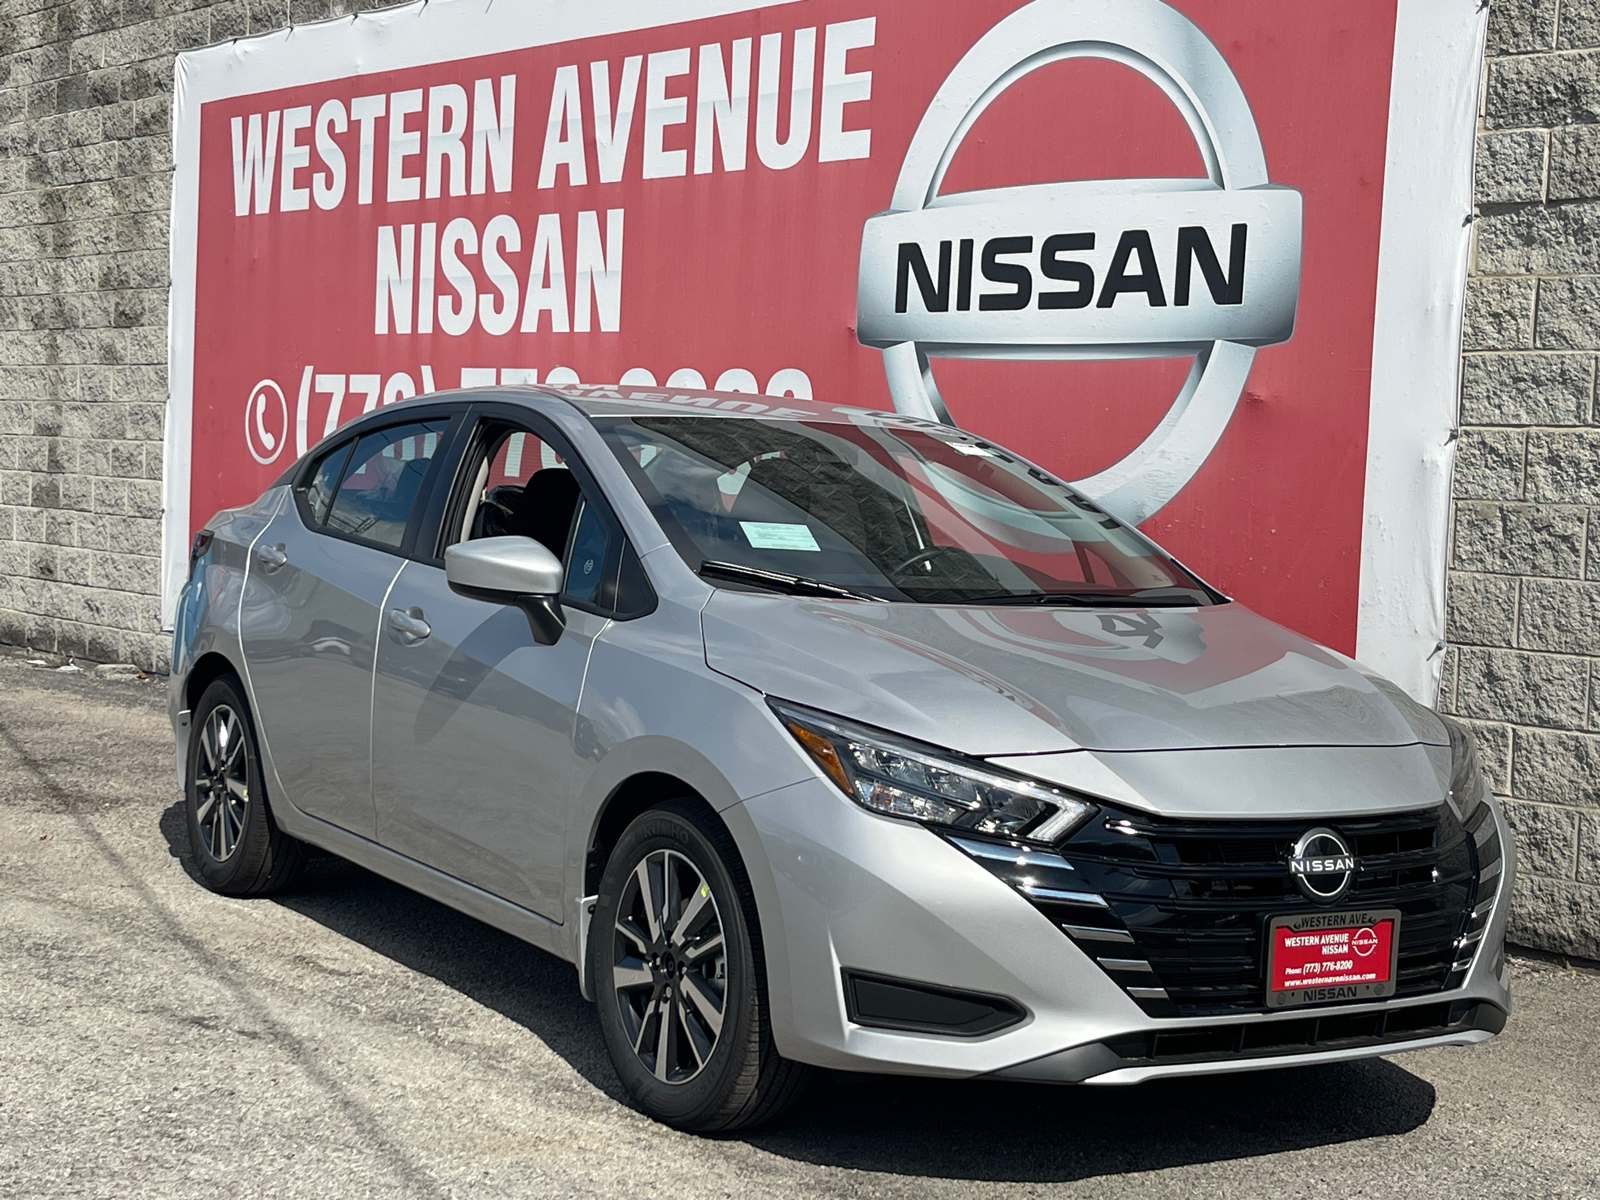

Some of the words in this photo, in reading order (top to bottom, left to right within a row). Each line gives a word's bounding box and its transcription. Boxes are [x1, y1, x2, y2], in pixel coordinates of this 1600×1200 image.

[230, 74, 516, 217] WESTERN
[537, 16, 877, 189] AVENUE
[374, 208, 625, 336] NISSAN
[894, 223, 1248, 314] NISSAN
[642, 820, 689, 844] KUMHO
[1291, 857, 1354, 872] NISSAN
[1301, 915, 1346, 928] WESTERN
[1349, 913, 1367, 925] AVE
[1284, 935, 1319, 947] WESTERN
[1320, 933, 1349, 945] AVENUE
[1322, 944, 1348, 955] NISSAN
[1303, 962, 1321, 975] (773)
[1322, 960, 1353, 972] 776-8200
[1284, 973, 1376, 987] www.westernavenissan.com
[1303, 986, 1357, 1001] NISSAN
